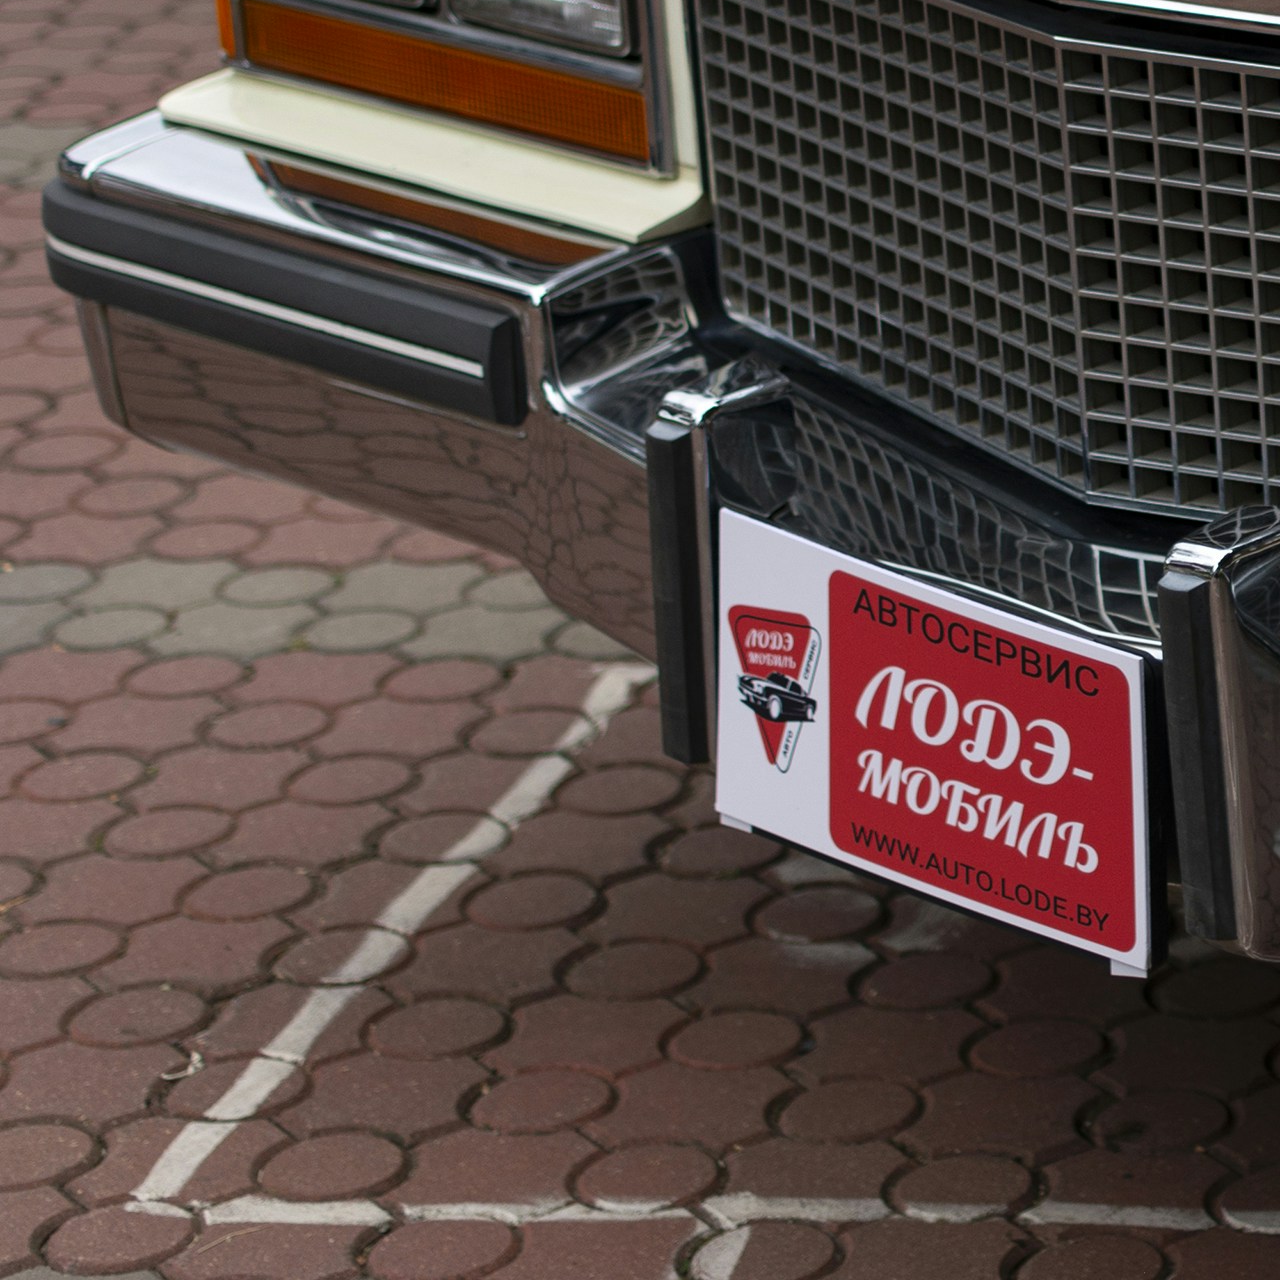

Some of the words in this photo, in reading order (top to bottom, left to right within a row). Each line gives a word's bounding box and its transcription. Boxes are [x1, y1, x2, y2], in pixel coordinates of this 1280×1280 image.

[744, 628, 795, 652] ЛОДЭ
[747, 651, 797, 670] МОБИЛЬ
[852, 587, 1100, 697] АВТОСЕРВИС
[782, 730, 794, 756] АВТО
[803, 639, 819, 680] СЕРВИС
[854, 664, 1094, 786] ЛОДЭ-
[856, 748, 1100, 875] МОБИЛЬ
[851, 822, 1109, 933] WWW.AUTO.LODE.BY
